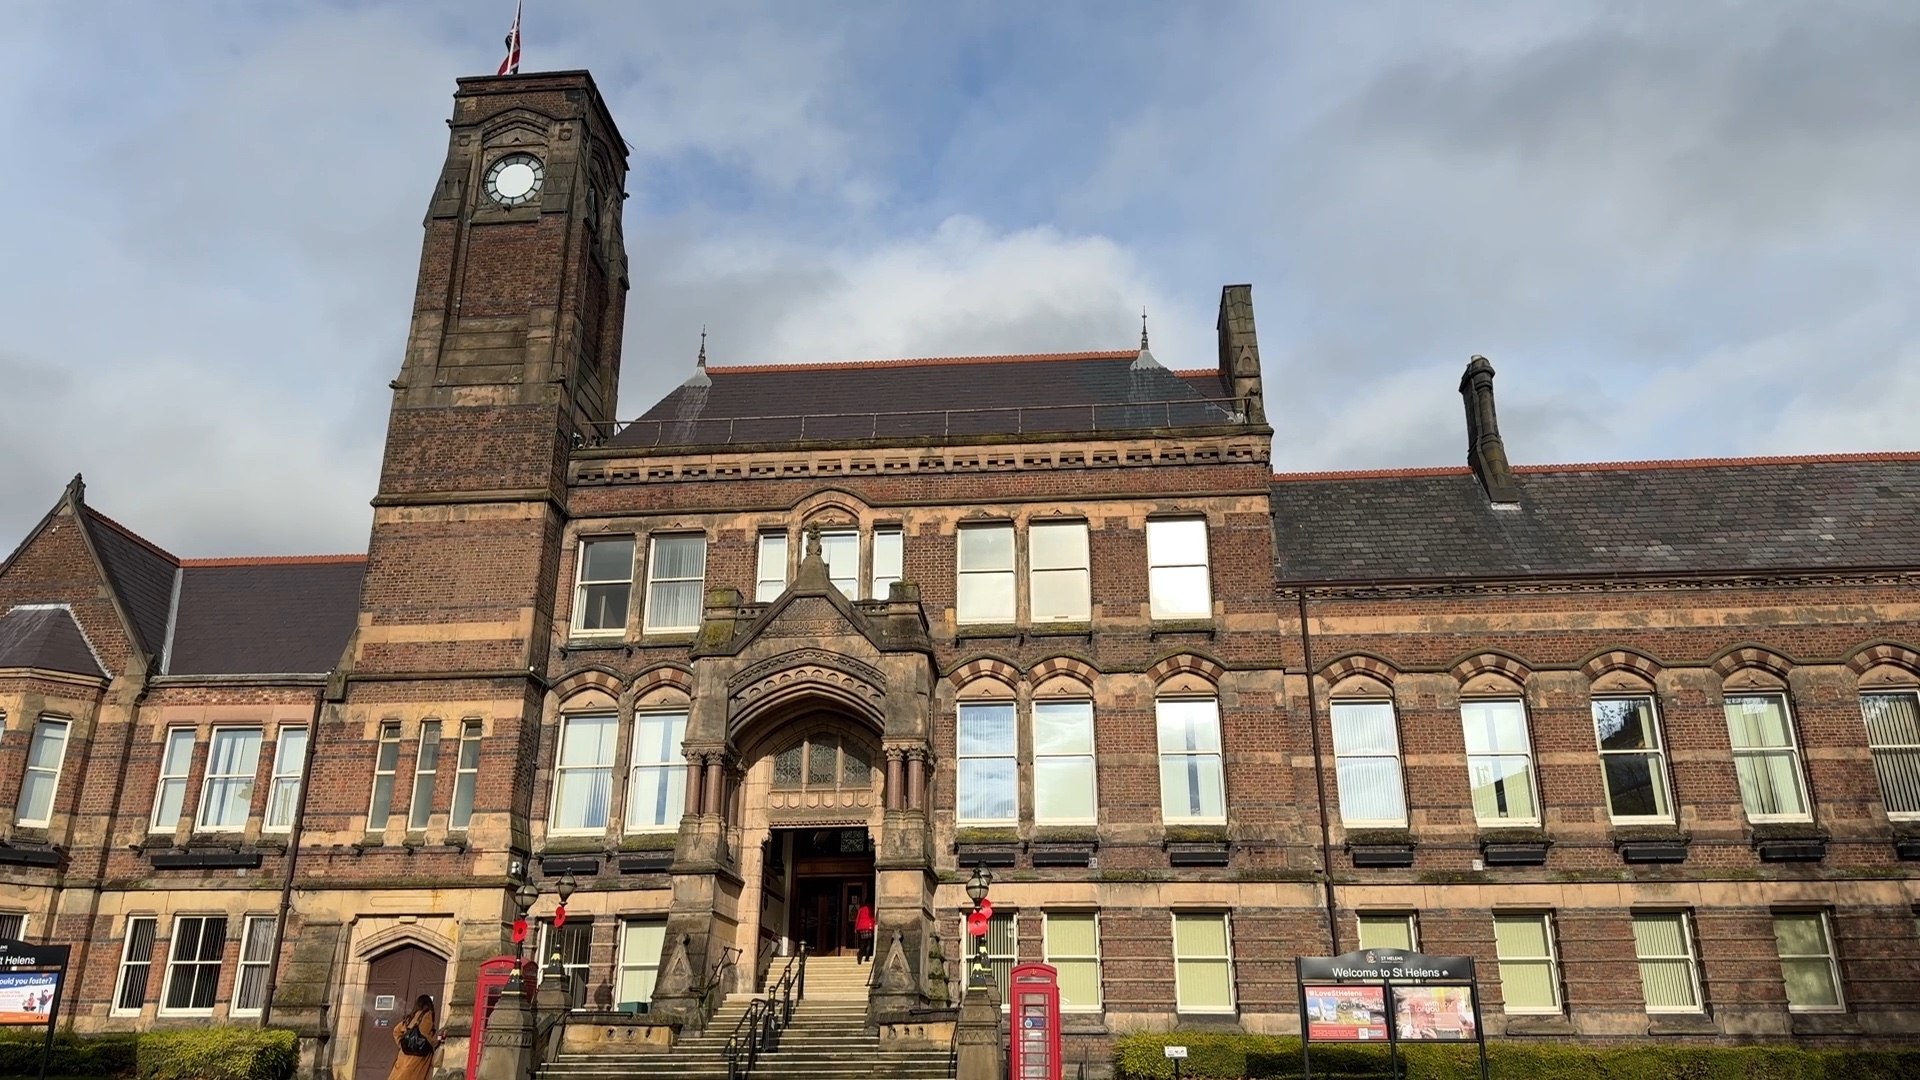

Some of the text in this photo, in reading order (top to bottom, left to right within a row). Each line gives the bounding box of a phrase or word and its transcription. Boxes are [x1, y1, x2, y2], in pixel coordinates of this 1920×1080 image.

[4, 955, 36, 965] Helens
[1332, 967, 1440, 977] Welcome to St Helens
[0, 976, 53, 986] ould you foster?
